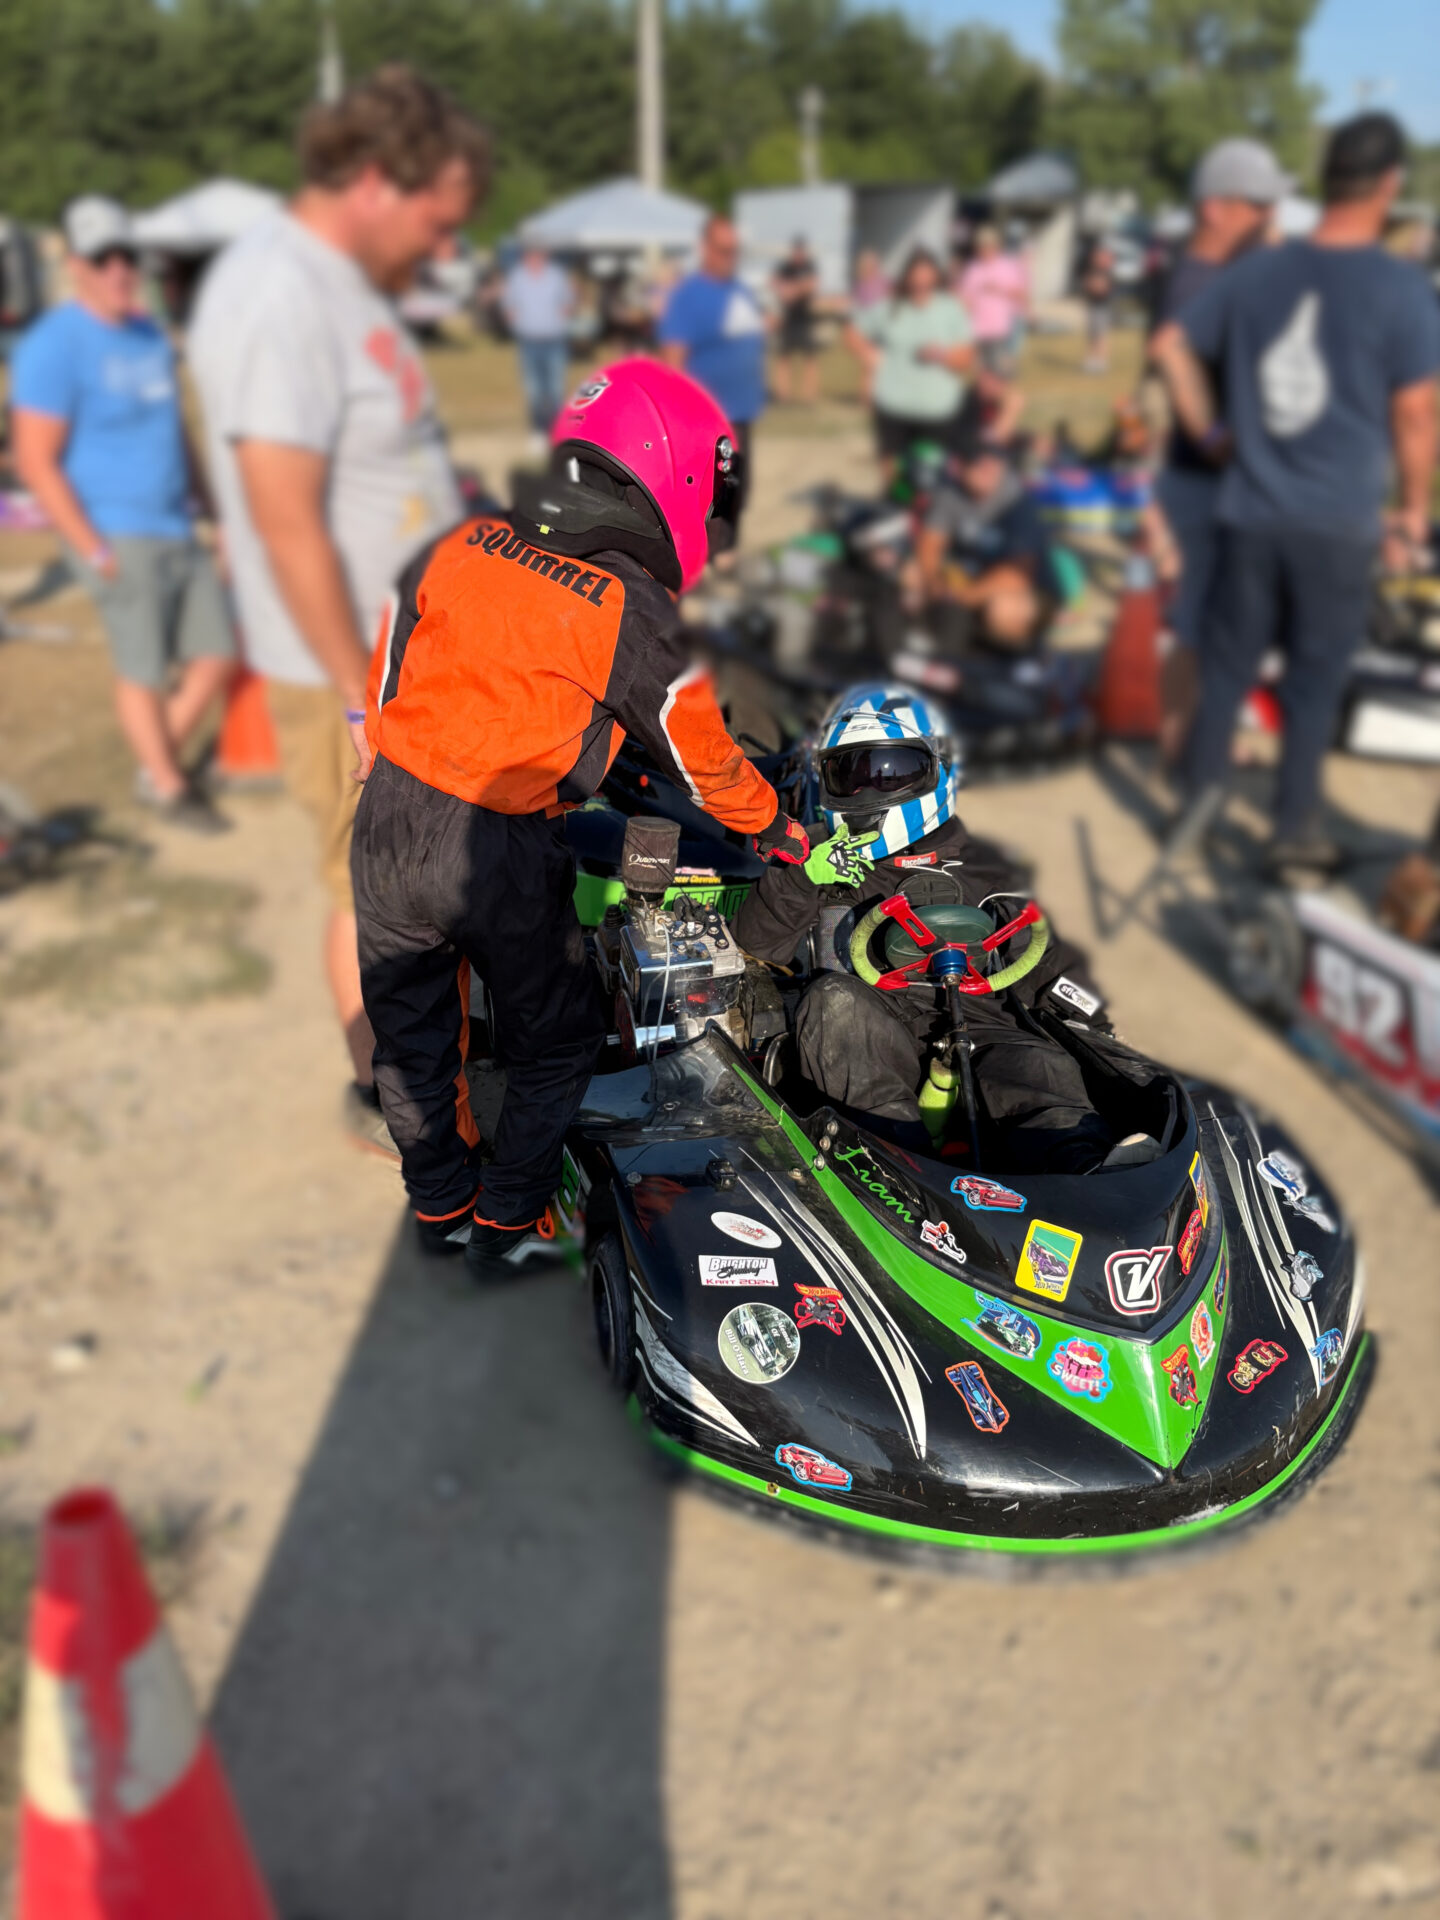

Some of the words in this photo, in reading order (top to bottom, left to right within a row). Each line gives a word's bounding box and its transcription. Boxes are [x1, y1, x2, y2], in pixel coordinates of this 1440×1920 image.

[467, 523, 612, 608] SQUIRREL
[834, 1146, 915, 1224] Liam
[709, 1257, 768, 1272] BRIGHTON
[724, 1328, 736, 1344] Bill
[732, 1344, 750, 1376] O'Hara
[1052, 1365, 1101, 1394] SWEET!
